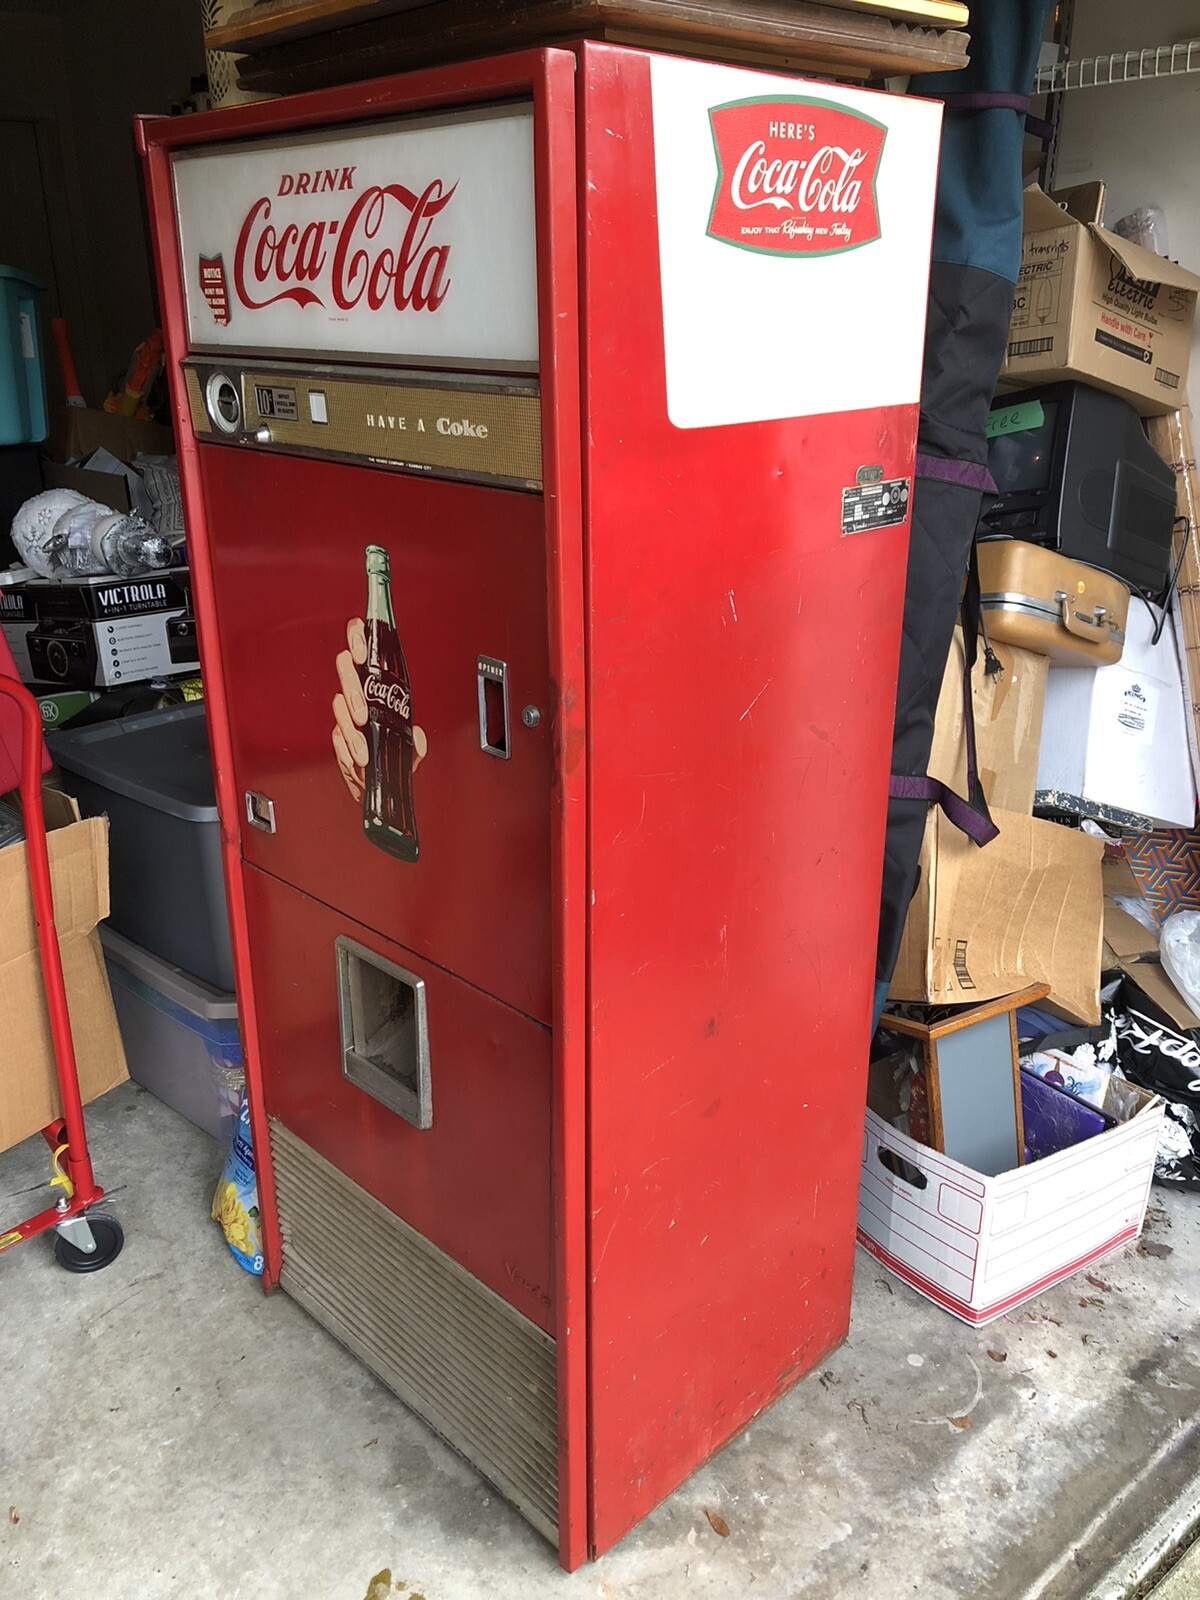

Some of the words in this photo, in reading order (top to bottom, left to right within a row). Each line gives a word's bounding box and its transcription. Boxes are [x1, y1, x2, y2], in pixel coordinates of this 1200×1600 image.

[769, 121, 815, 141] HERE'S
[277, 166, 357, 197] DRINK
[731, 140, 868, 213] Coca-Cola
[741, 226, 763, 235] ENJOY
[764, 226, 781, 235] THAT
[815, 227, 829, 235] NEW
[233, 177, 461, 312] Coca-Cola
[203, 268, 222, 279] NOTICE
[1101, 293, 1113, 306] High
[1113, 298, 1130, 315] Quality
[1130, 304, 1143, 320] Light
[1143, 310, 1158, 326] Bulbs
[1100, 312, 1120, 330] Handle
[1120, 322, 1133, 337] with
[1133, 327, 1147, 342] Care
[366, 414, 407, 430] HAVE
[417, 419, 425, 432] A
[436, 418, 488, 438] Coke
[98, 583, 166, 607] VICTROLA
[104, 605, 127, 614] 4-IN-1
[129, 600, 168, 611] TURNTABLE
[478, 662, 503, 677] OPENER
[364, 674, 410, 719] Coca-Cola
[42, 705, 55, 718] 6X
[254, 1255, 264, 1271] 8
